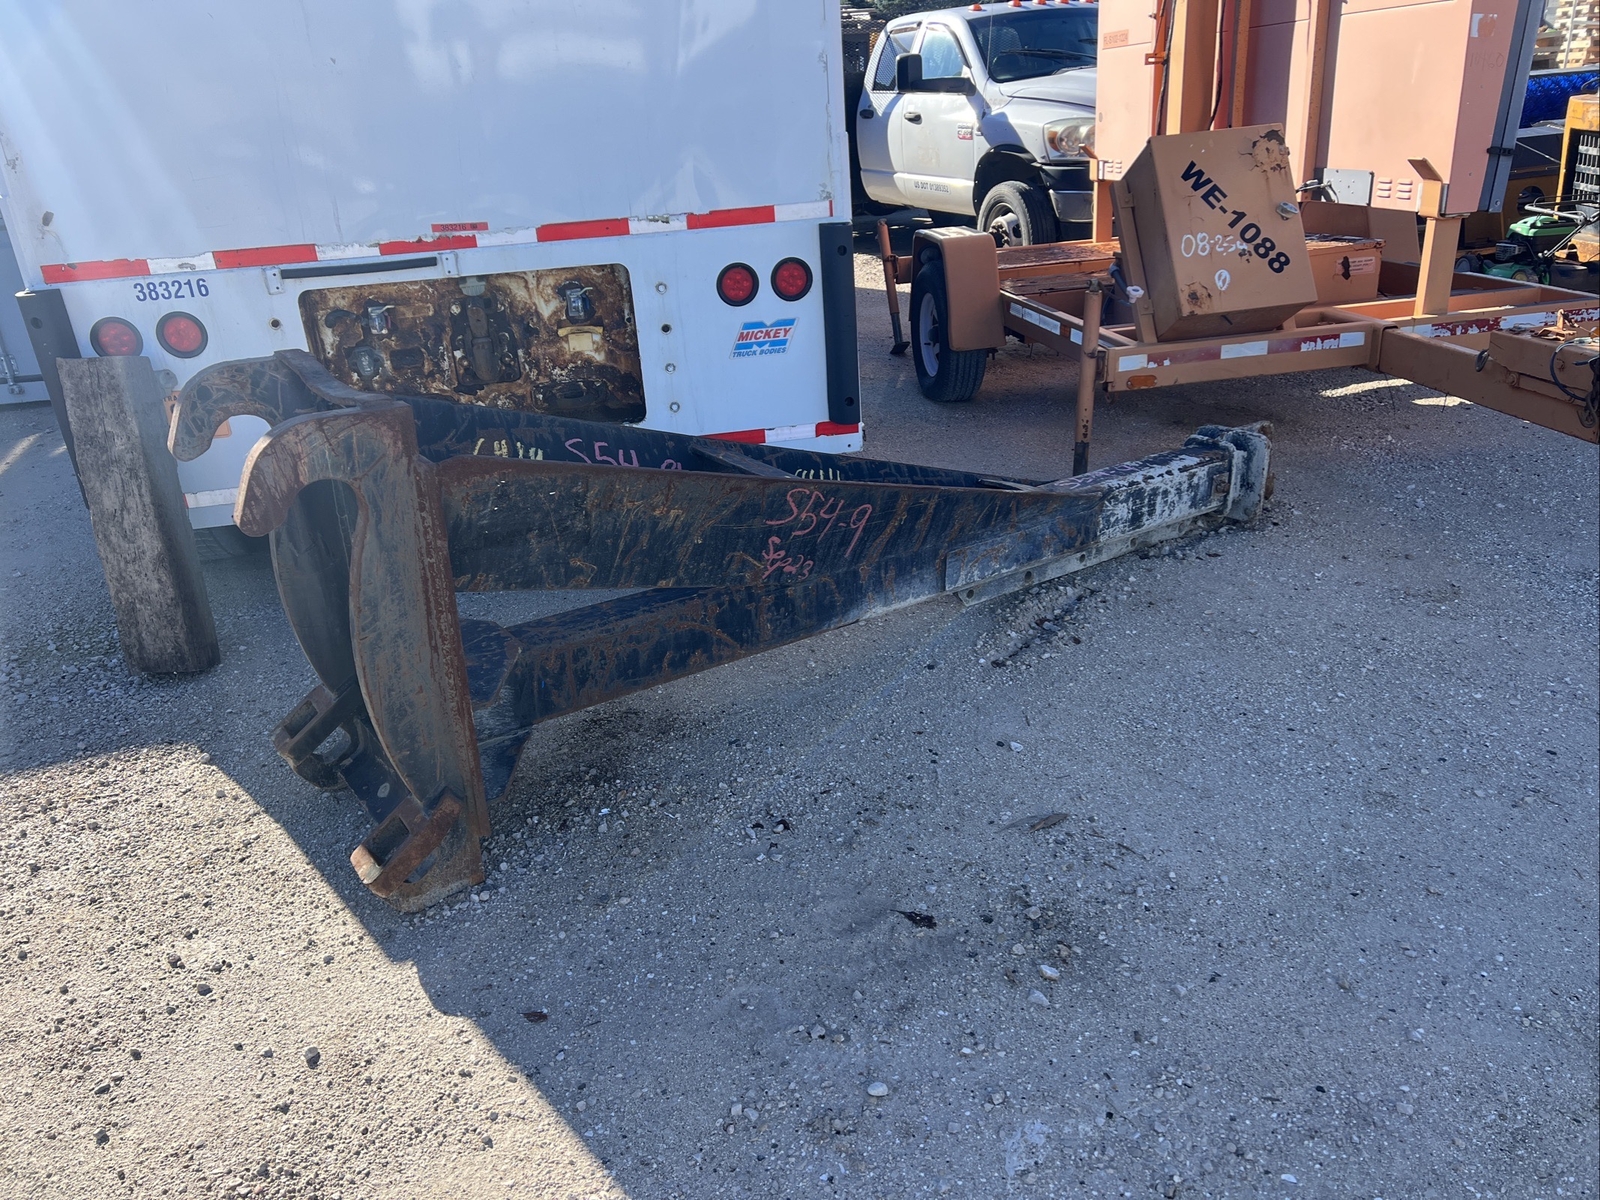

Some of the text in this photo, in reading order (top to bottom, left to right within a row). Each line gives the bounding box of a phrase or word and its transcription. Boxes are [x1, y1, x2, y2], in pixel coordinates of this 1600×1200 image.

[1181, 160, 1291, 274] WE-1088
[440, 223, 467, 231] 383216
[133, 278, 210, 302] 383216
[737, 327, 792, 342] MICKEY
[732, 347, 787, 358] TRUCK BODIES
